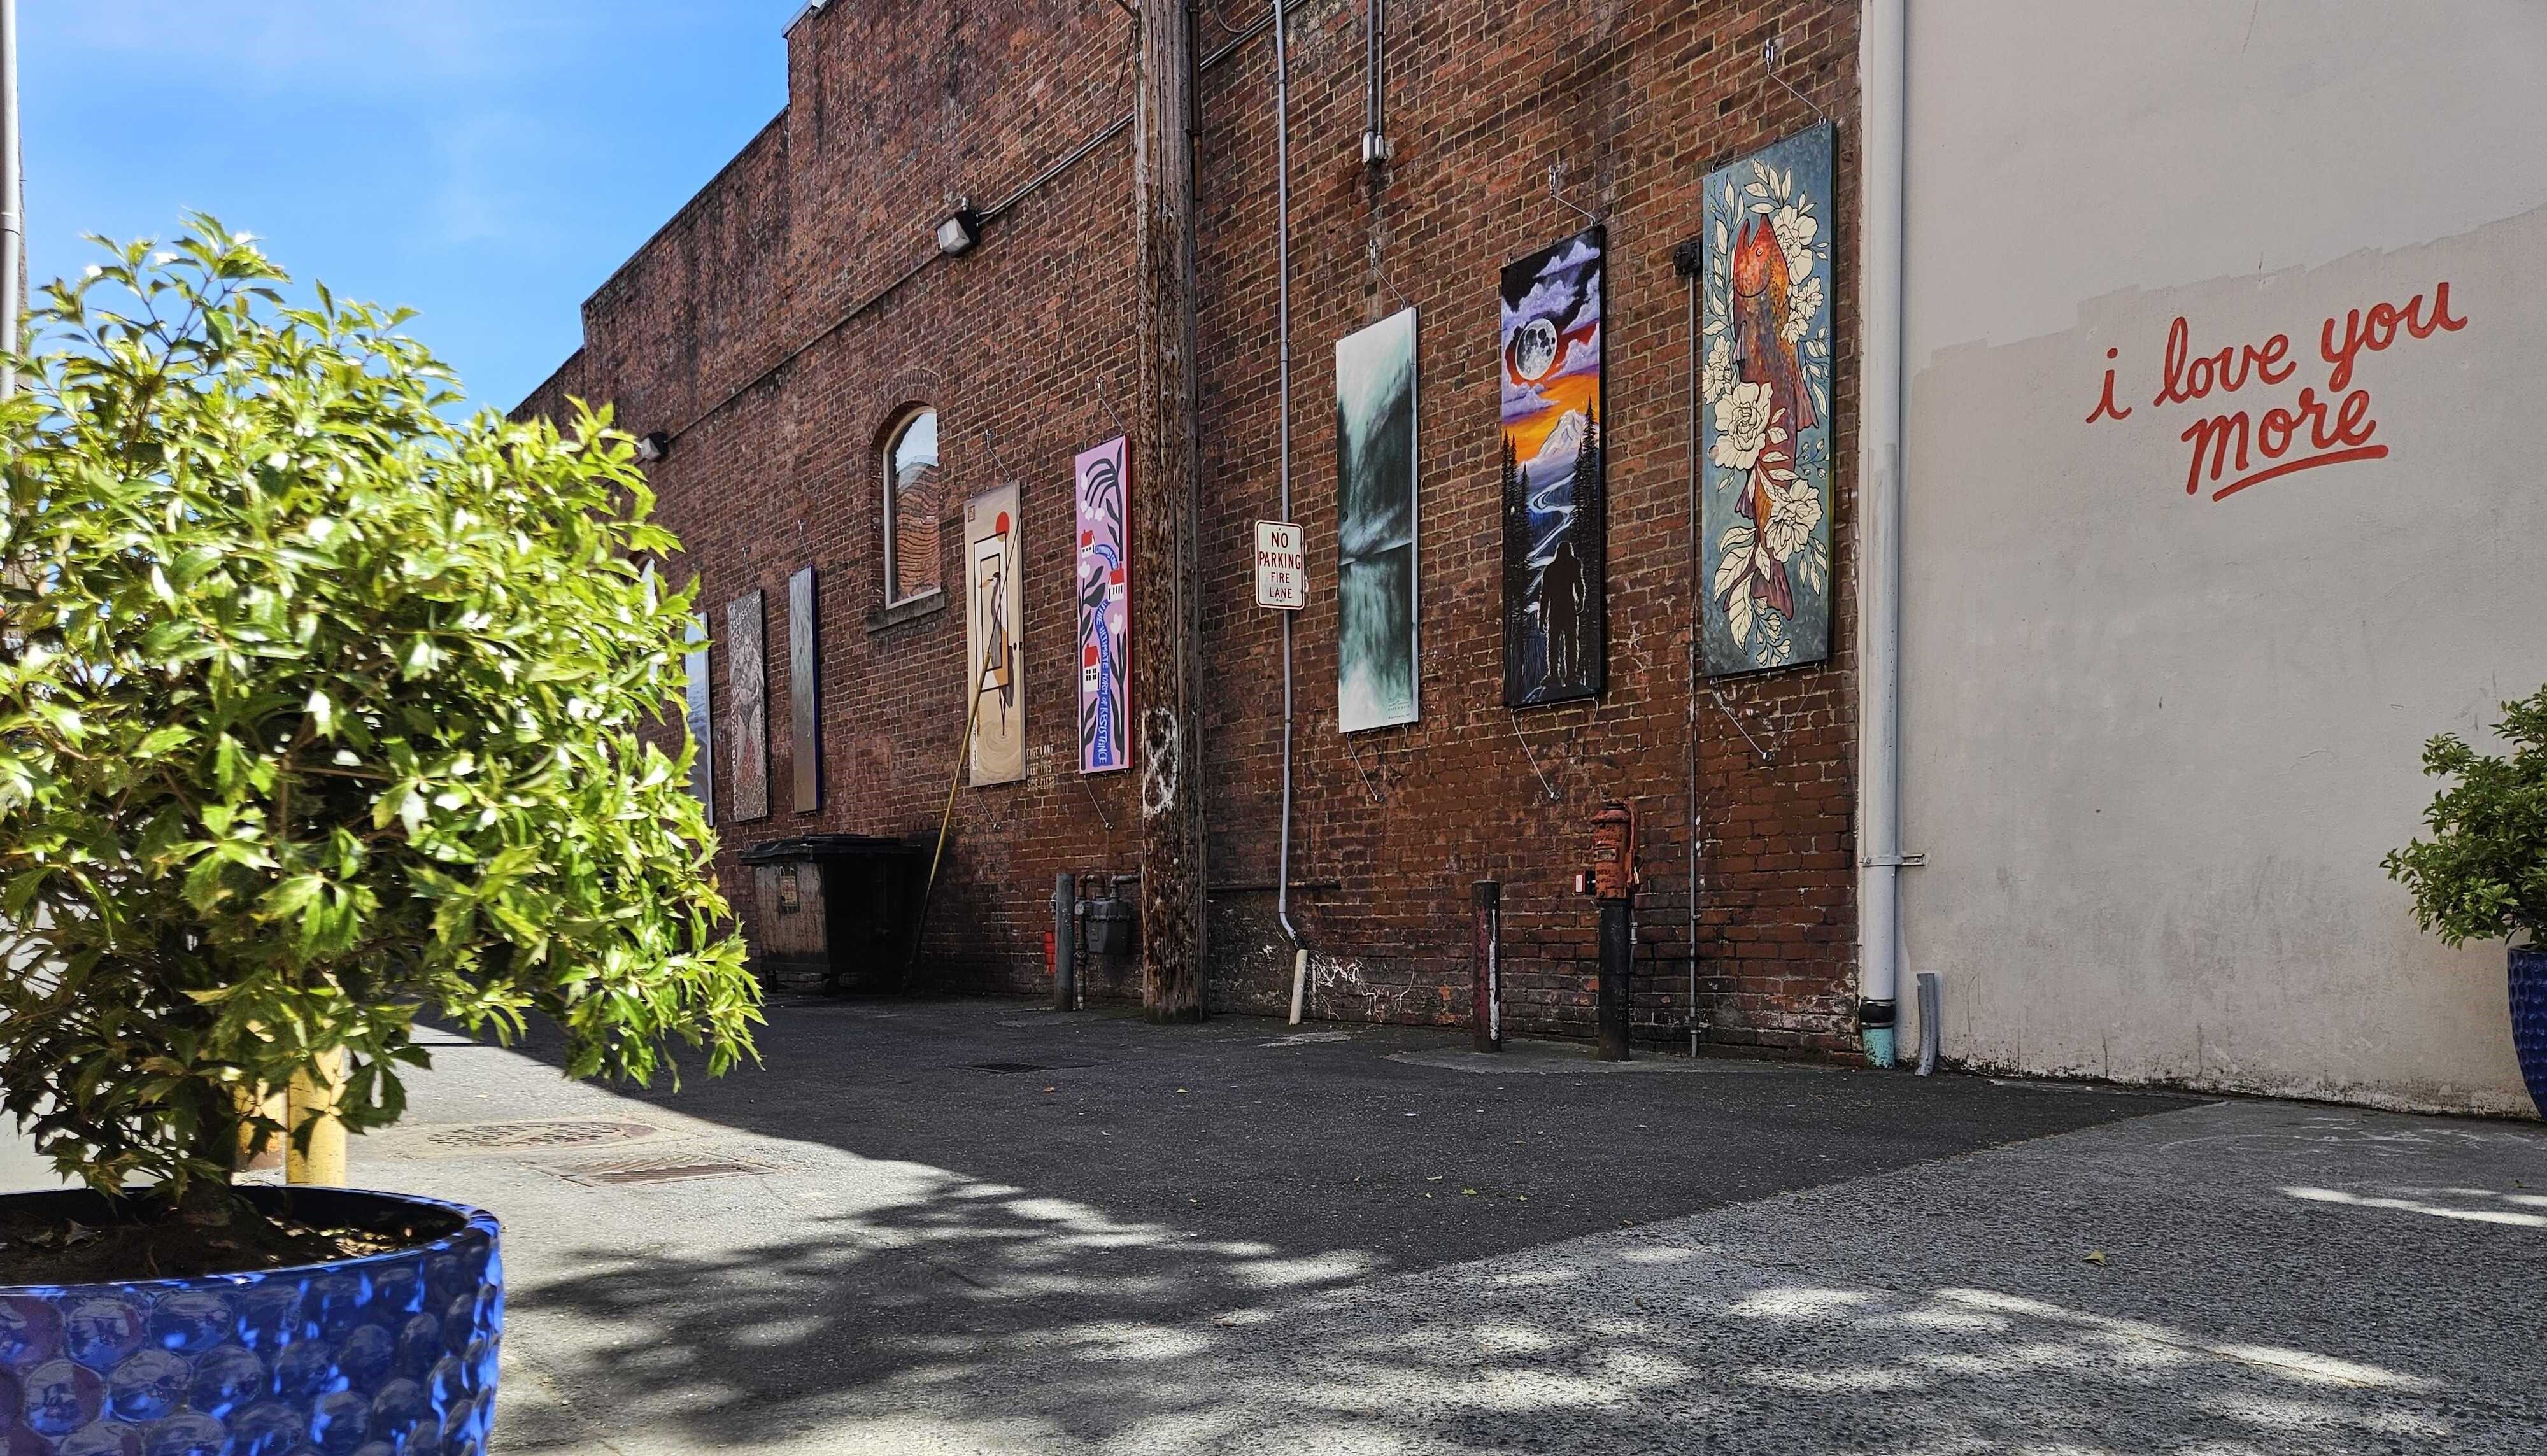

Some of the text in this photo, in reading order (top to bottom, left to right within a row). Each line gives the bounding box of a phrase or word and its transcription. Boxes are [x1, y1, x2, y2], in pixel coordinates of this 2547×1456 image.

[2085, 281, 2467, 424] i love you
[2181, 387, 2376, 495] more
[1272, 532, 1288, 548] NO
[1259, 551, 1301, 570] PARKING
[1270, 586, 1293, 599] LANE
[1271, 572, 1290, 584] FIRE
[1099, 626, 1109, 668] ULTIMATE
[1097, 707, 1109, 763] RESISTANCE
